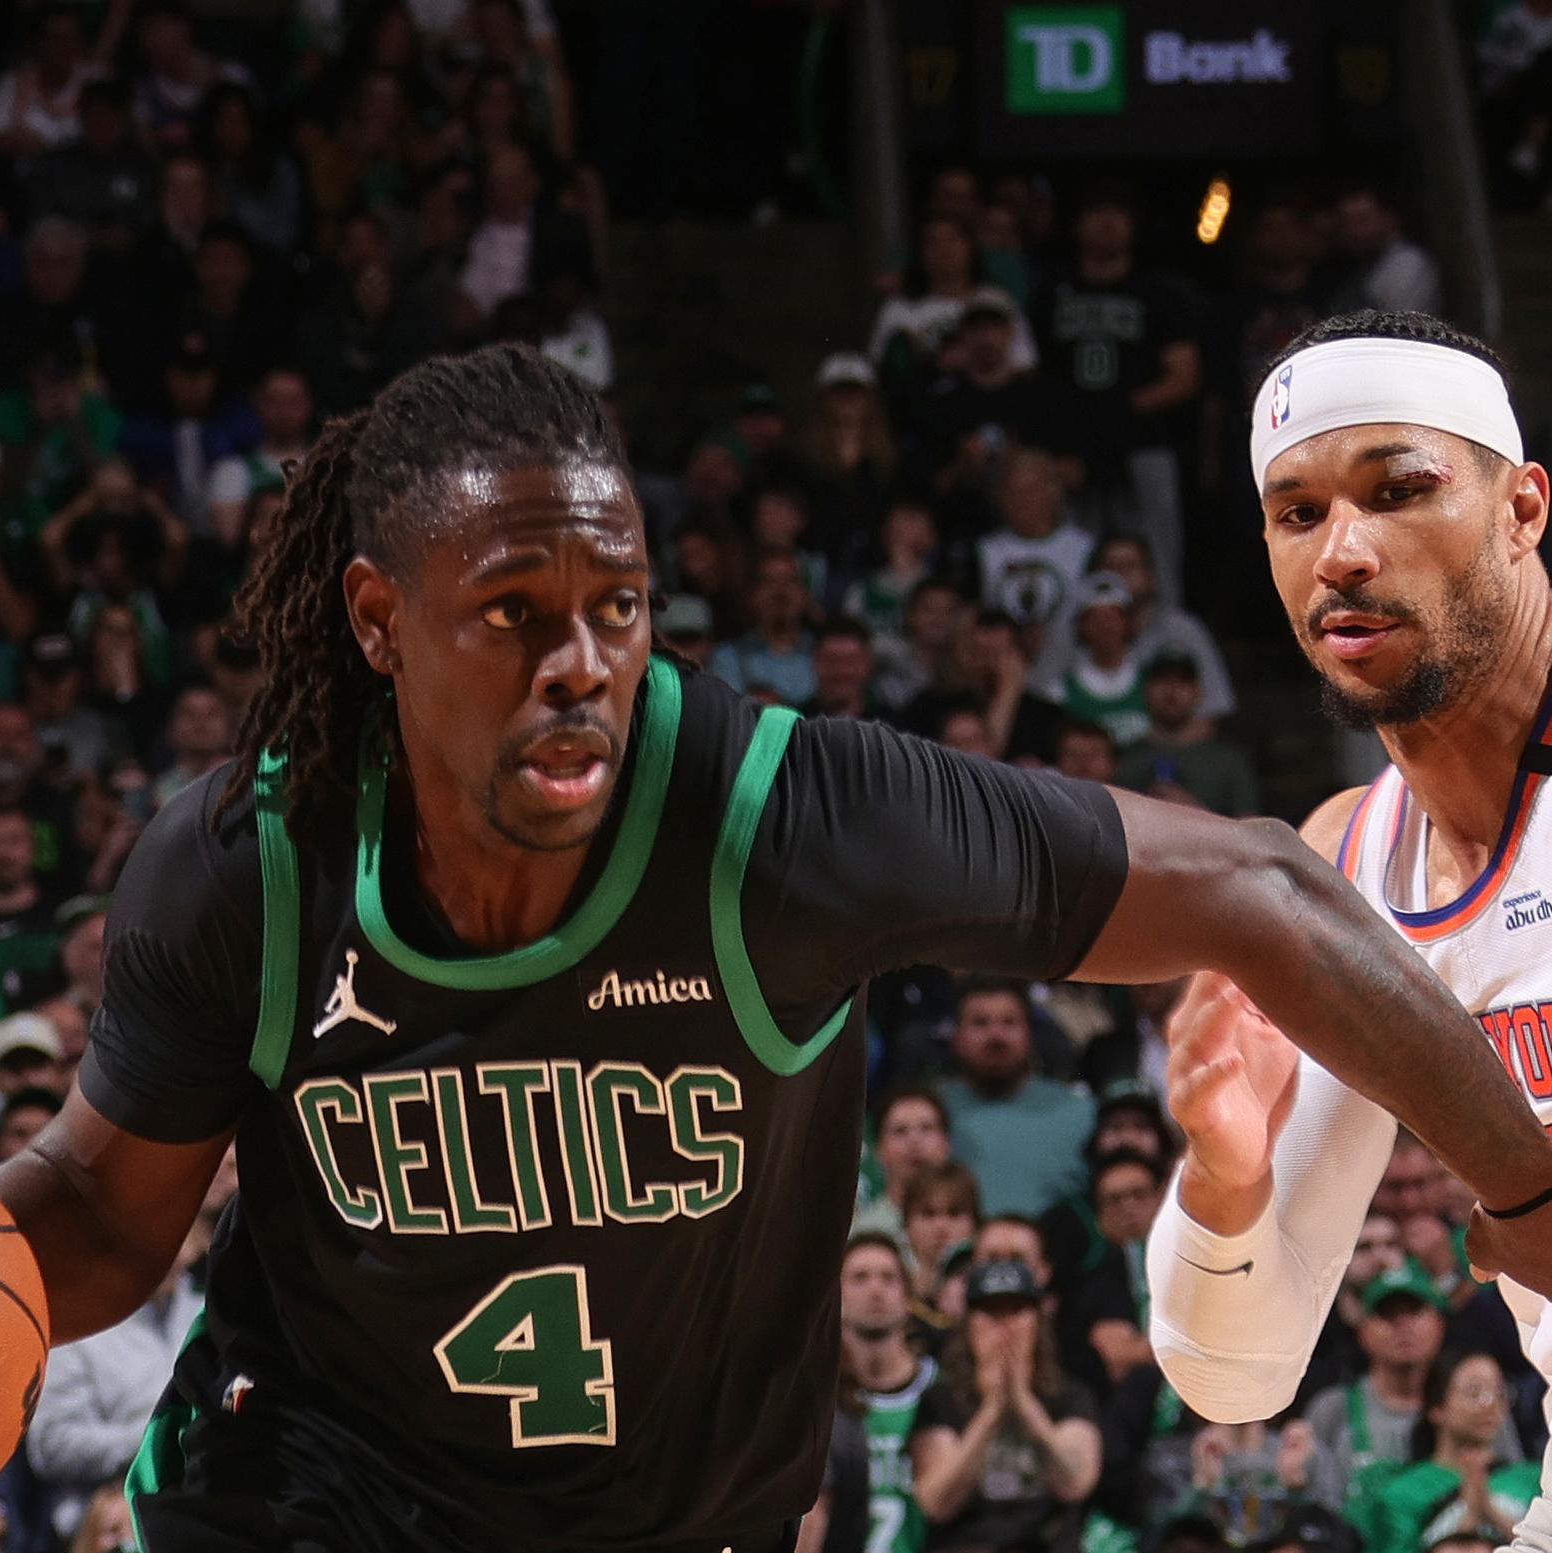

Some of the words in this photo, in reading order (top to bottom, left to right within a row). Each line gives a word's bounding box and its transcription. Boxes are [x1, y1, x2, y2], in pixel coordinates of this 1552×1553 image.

[1015, 24, 1114, 94] TD
[1144, 29, 1293, 83] Bank
[1502, 890, 1542, 909] experience
[1505, 903, 1536, 931] abu
[587, 970, 713, 1010] Amica
[296, 1059, 744, 1235] CELTICS
[433, 1263, 616, 1448] 4
